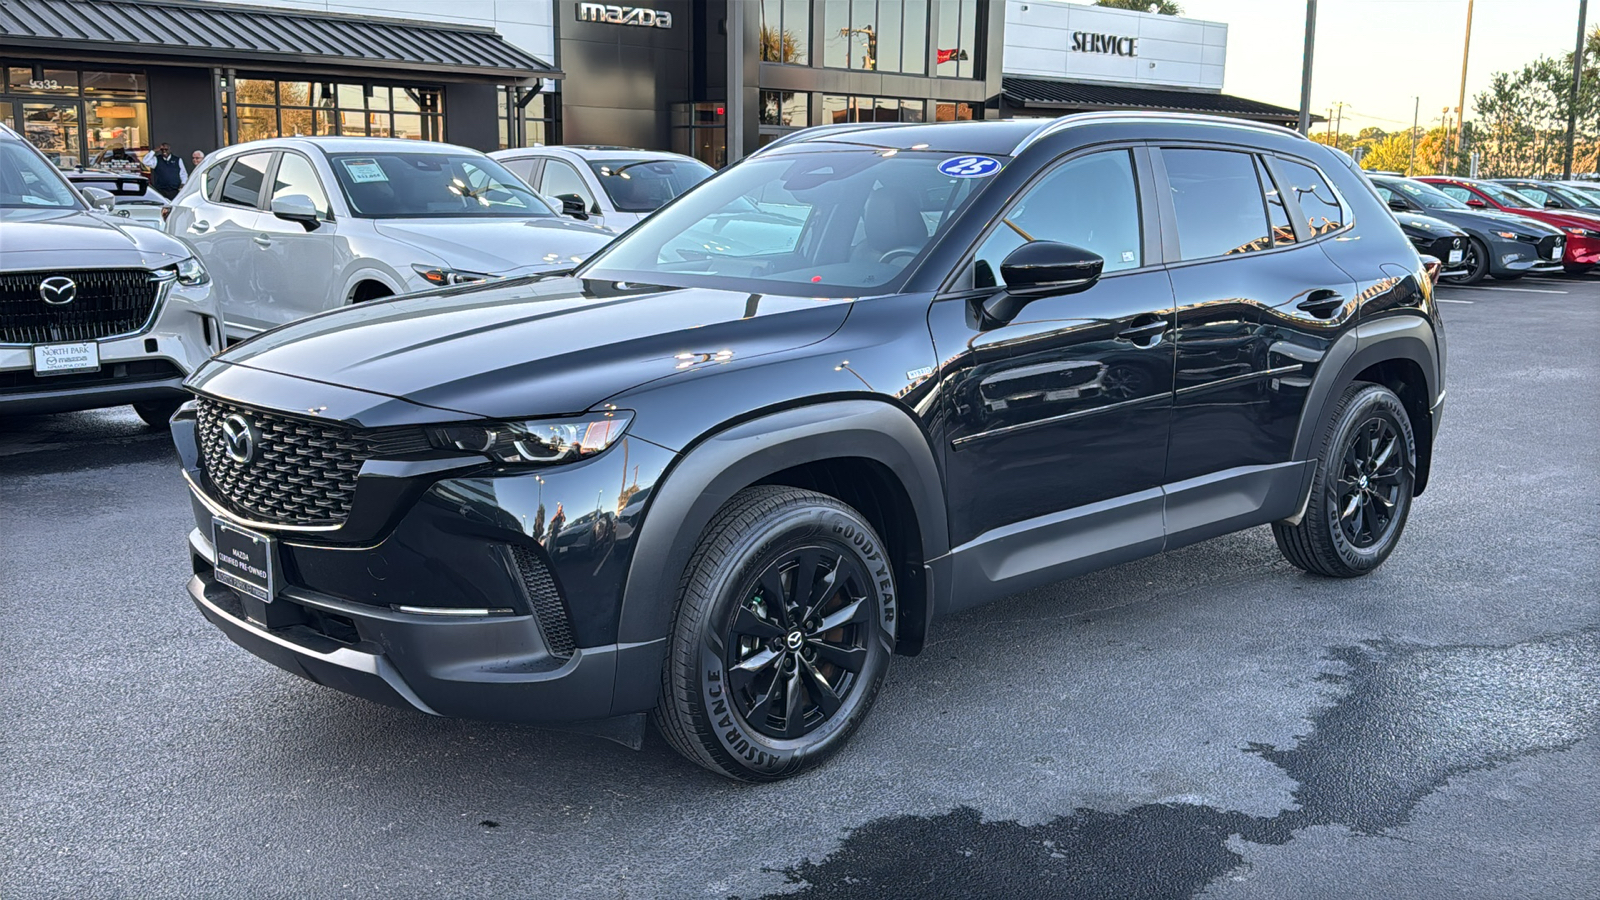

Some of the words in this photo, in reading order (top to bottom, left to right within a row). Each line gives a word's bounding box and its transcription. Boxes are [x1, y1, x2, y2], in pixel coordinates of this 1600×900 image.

[1071, 31, 1138, 57] SERVICE
[29, 78, 58, 90] 9333
[945, 158, 994, 175] 25
[42, 347, 69, 356] NORTH
[70, 346, 90, 355] PARK
[218, 552, 239, 567] CERTIFIED
[239, 561, 267, 579] PRE-OWNED
[232, 548, 250, 562] MAZDA
[832, 518, 895, 624] GOODYEAR
[706, 668, 782, 769] ASSURANCE
